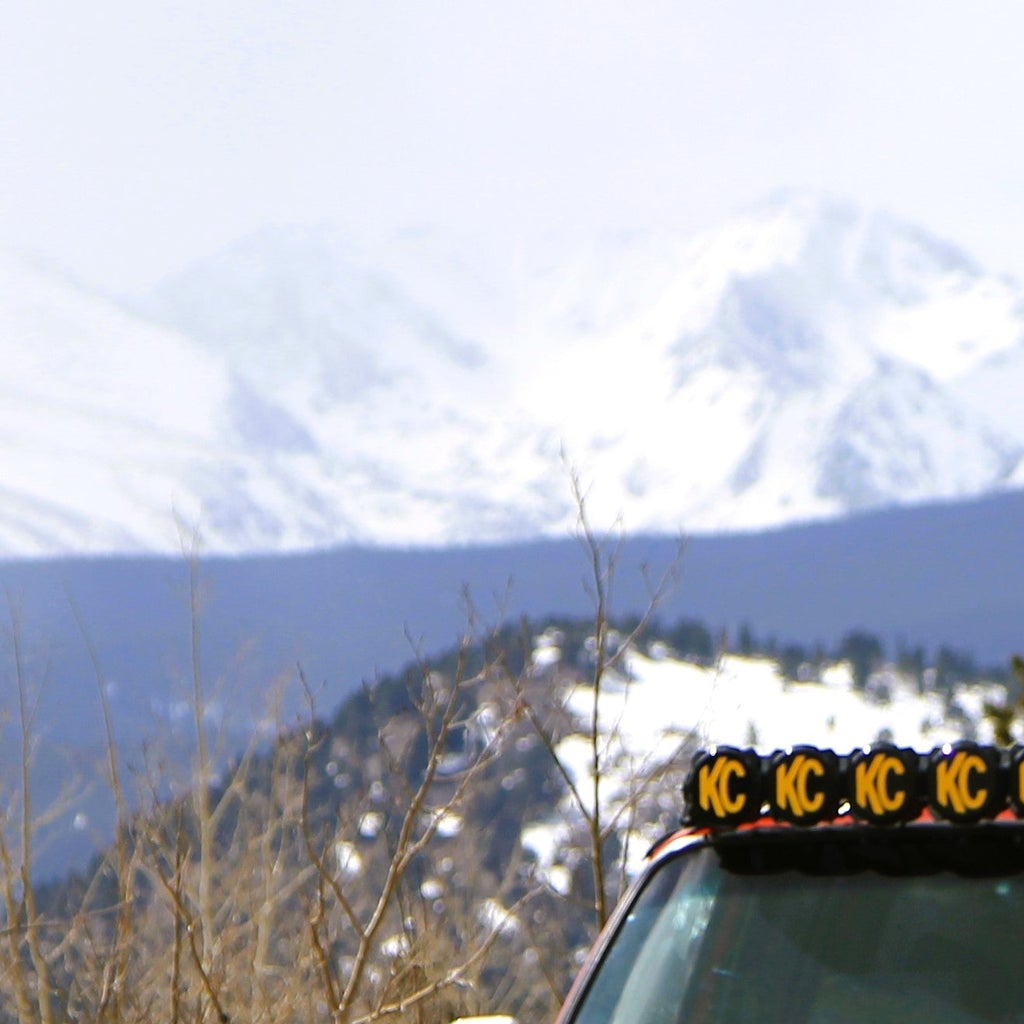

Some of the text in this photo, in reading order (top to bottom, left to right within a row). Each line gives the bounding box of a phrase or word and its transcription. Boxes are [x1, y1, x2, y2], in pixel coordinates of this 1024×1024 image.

[698, 755, 747, 819] KC
[775, 753, 826, 818] KC
[854, 752, 906, 816] KC
[935, 750, 988, 815] KC
